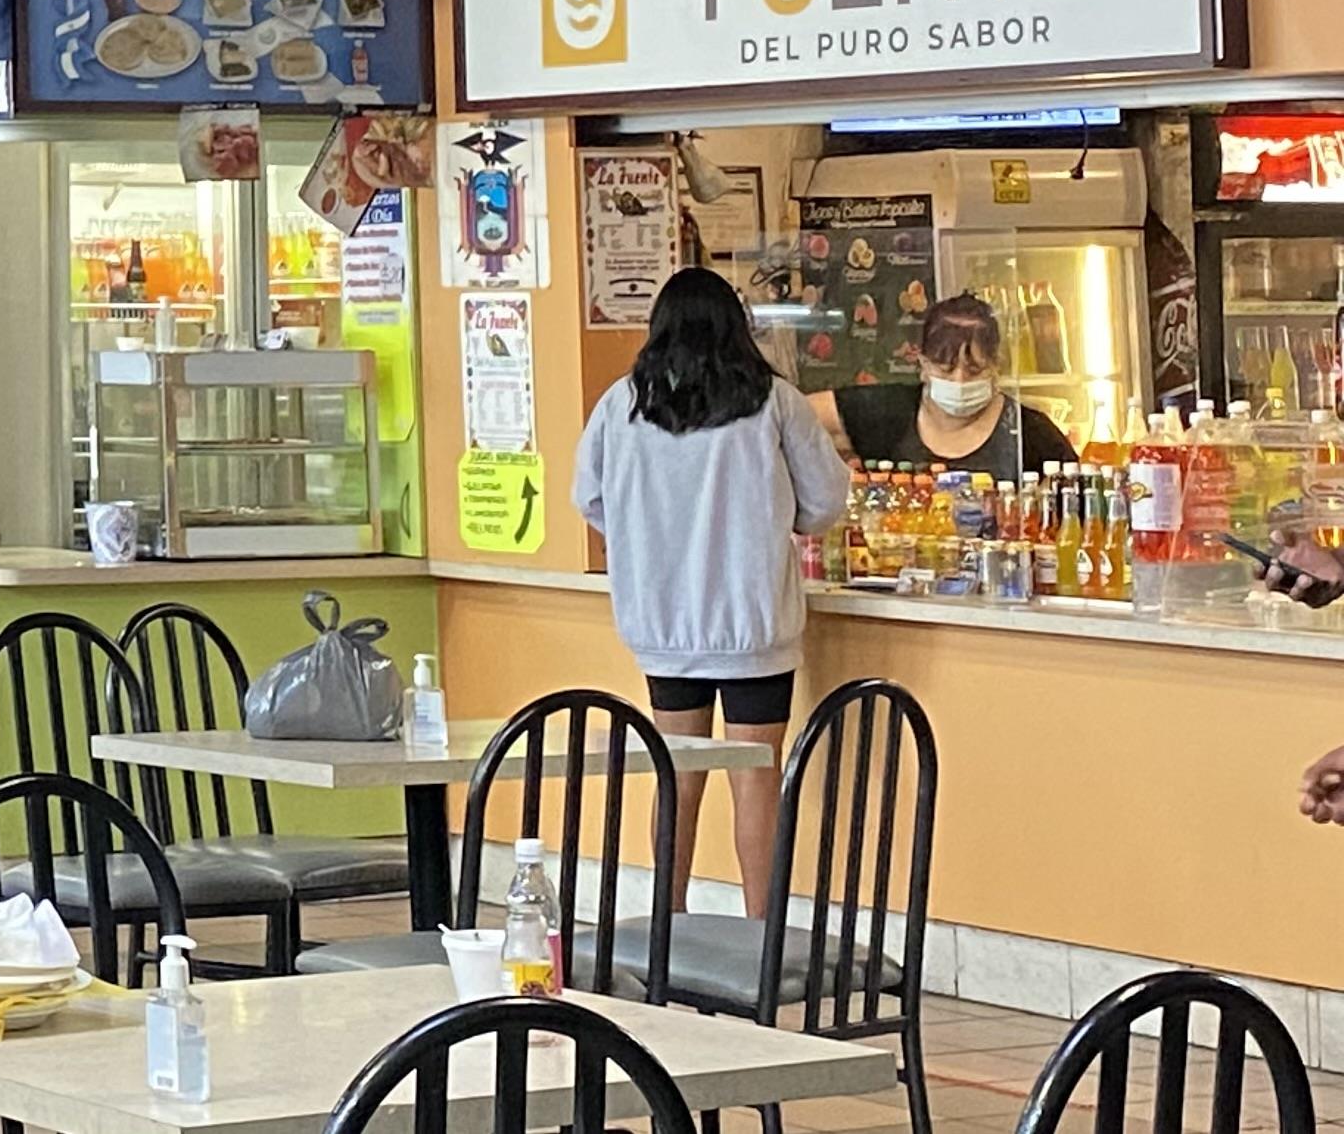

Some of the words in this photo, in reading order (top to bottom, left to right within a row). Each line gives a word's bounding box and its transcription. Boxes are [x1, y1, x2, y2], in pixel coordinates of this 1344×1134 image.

[741, 36, 800, 64] DEL
[817, 27, 909, 59] PURO
[928, 15, 1050, 51] SABOR
